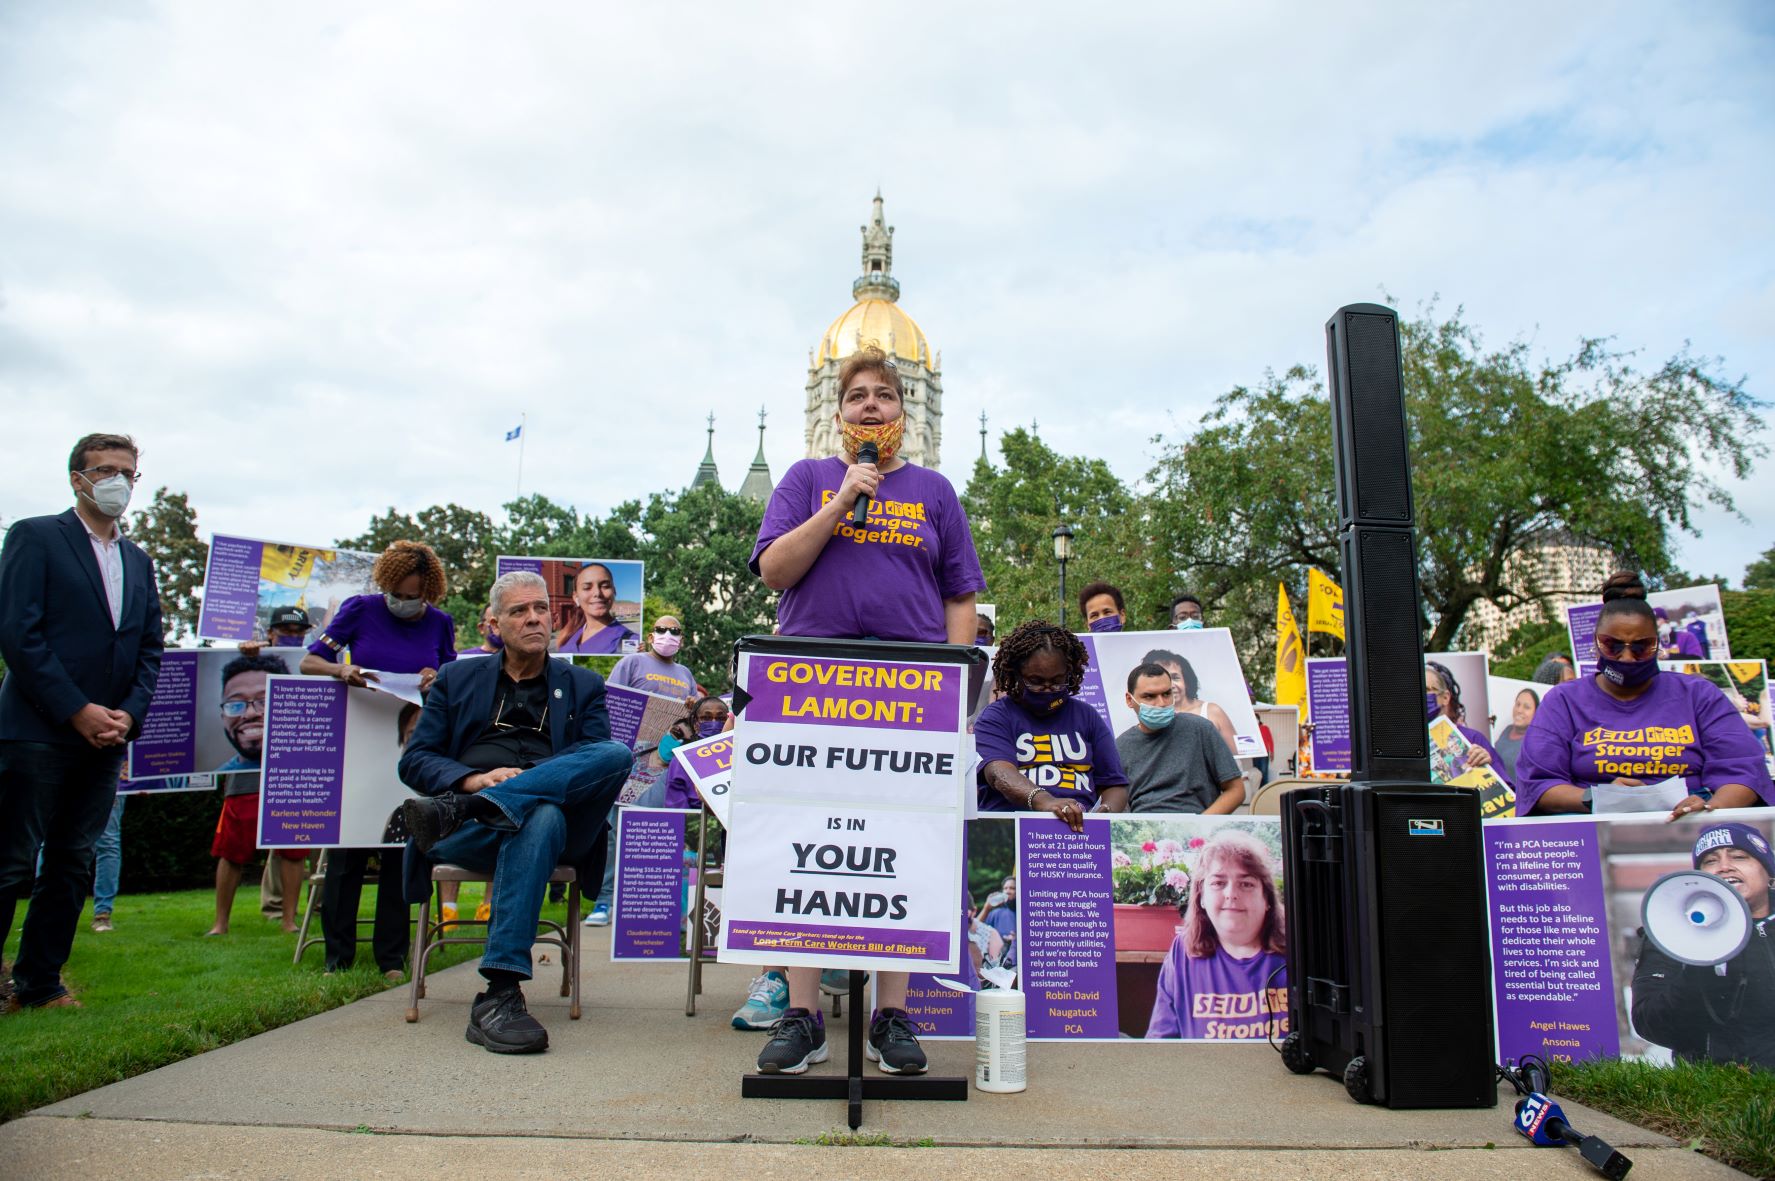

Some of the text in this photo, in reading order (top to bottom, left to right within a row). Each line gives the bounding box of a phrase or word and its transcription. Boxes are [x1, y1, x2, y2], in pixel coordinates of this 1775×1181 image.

[832, 522, 923, 547] Together
[767, 661, 943, 691] GOVERNOR
[782, 695, 924, 723] LAMONT:
[1016, 731, 1087, 762] SEIU
[1595, 744, 1686, 760] Stronger
[746, 742, 818, 767] OUR
[826, 747, 954, 775] FUTURE
[1594, 760, 1688, 776] Together
[1481, 791, 1516, 816] ave
[827, 817, 866, 831] IS IN
[1711, 836, 1732, 846] ALL
[792, 842, 897, 873] YOUR
[1544, 850, 1577, 858] people.
[1520, 882, 1570, 890] disabilities.
[1030, 890, 1058, 899] Limiting
[775, 888, 908, 920] HANDS
[1563, 915, 1594, 923] lifeline
[1579, 926, 1599, 934] who
[753, 936, 777, 946] Long
[780, 938, 802, 946] Term
[804, 940, 826, 948] Care
[828, 940, 866, 950] Workers
[885, 944, 895, 952] of
[896, 944, 926, 954] Rights
[1045, 940, 1075, 948] monthly
[1077, 940, 1106, 948] utilities,
[1540, 970, 1566, 979] being
[1566, 982, 1600, 990] treated
[906, 988, 964, 998] thia Johnson
[1046, 991, 1099, 1000] Robin David
[1194, 992, 1257, 1017] SEIU
[924, 1006, 952, 1014] Haven
[1050, 1008, 1097, 1018] Naugatuck
[918, 1022, 936, 1032] PCA
[1065, 1025, 1083, 1033] PCA
[1205, 1018, 1288, 1039] Stronge
[1530, 1021, 1590, 1031] Angel Hawes
[1543, 1038, 1580, 1047] Ansonia
[1553, 1055, 1572, 1063] PCA
[1521, 1098, 1542, 1127] 61
[1530, 1104, 1549, 1134] NEWS
